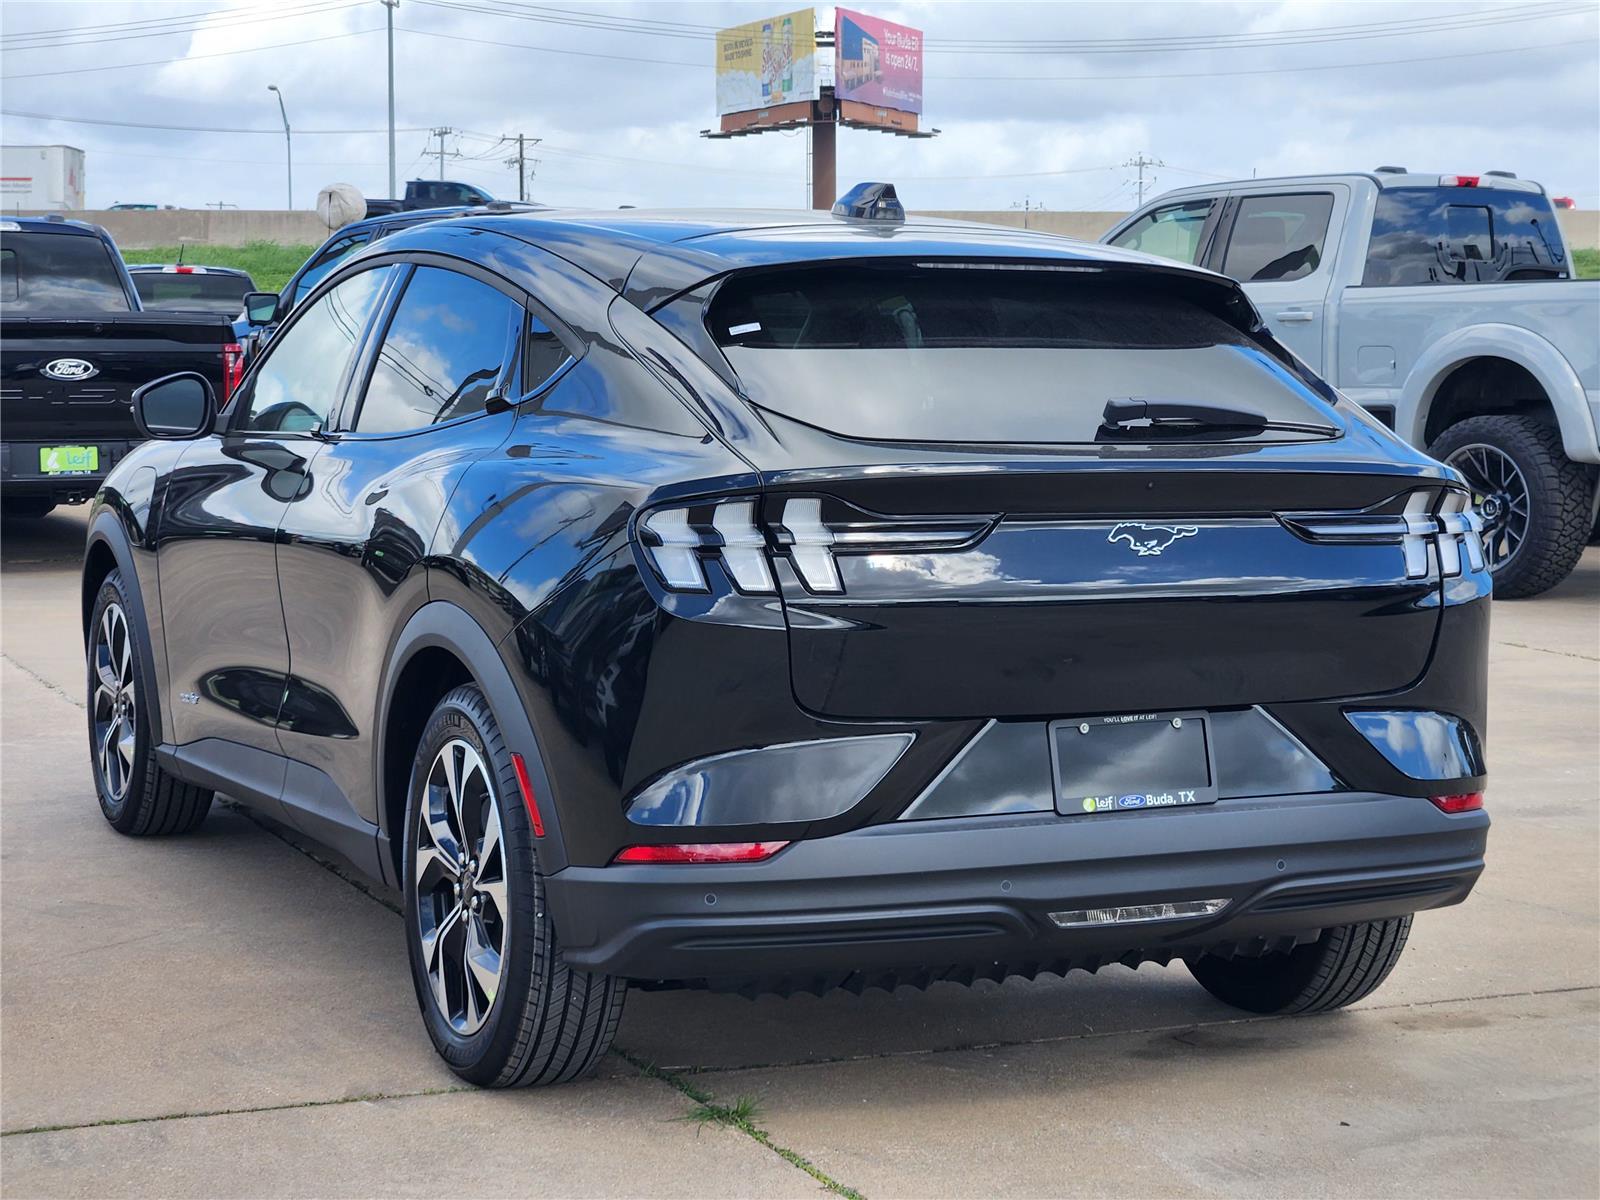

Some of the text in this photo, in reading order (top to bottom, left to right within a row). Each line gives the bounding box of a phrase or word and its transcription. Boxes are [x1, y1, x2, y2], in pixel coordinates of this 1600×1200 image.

[890, 54, 905, 70] open
[54, 361, 85, 375] Ford
[1121, 715, 1133, 723] LOVE
[1146, 792, 1177, 806] Buda,
[1178, 790, 1196, 803] TX
